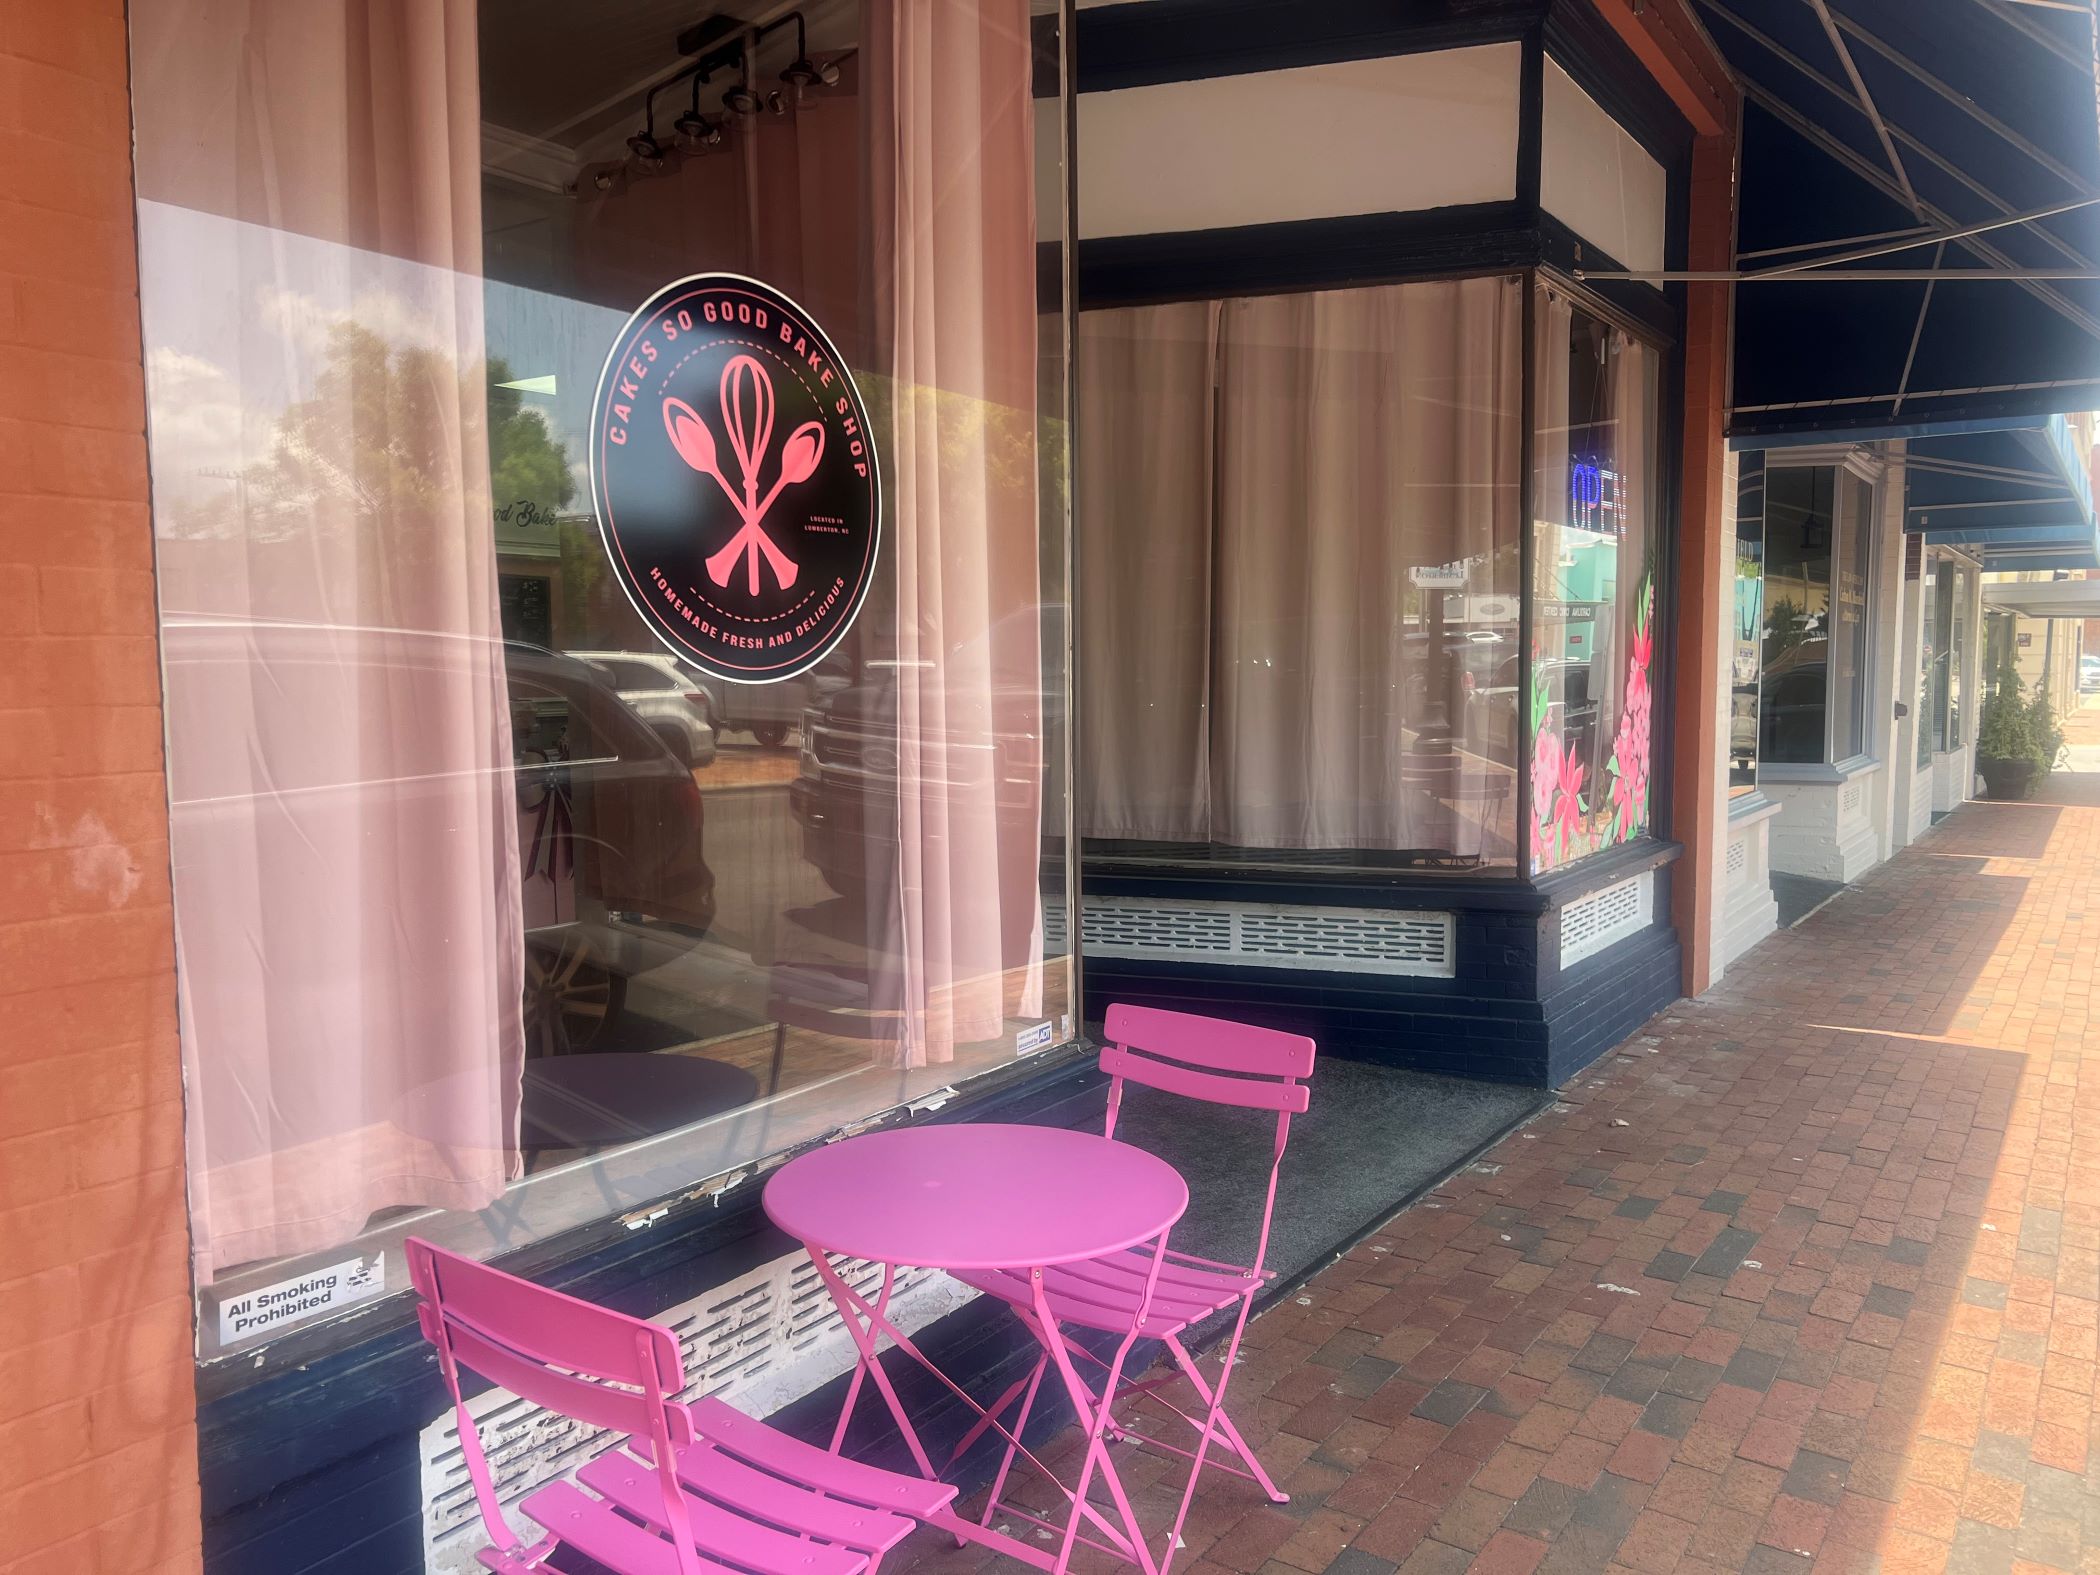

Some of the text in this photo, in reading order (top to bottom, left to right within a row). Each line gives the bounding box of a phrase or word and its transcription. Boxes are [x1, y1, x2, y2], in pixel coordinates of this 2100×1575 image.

[610, 301, 867, 478] CAKES SO GOOD BAKE SHOP
[810, 516, 835, 524] LOCATED
[1572, 463, 1627, 541] OPEN
[650, 567, 845, 649] HOMEMADE FRESH AND DELICIOUS
[228, 1274, 337, 1318] All Smoking
[235, 1291, 332, 1332] Prohibited
